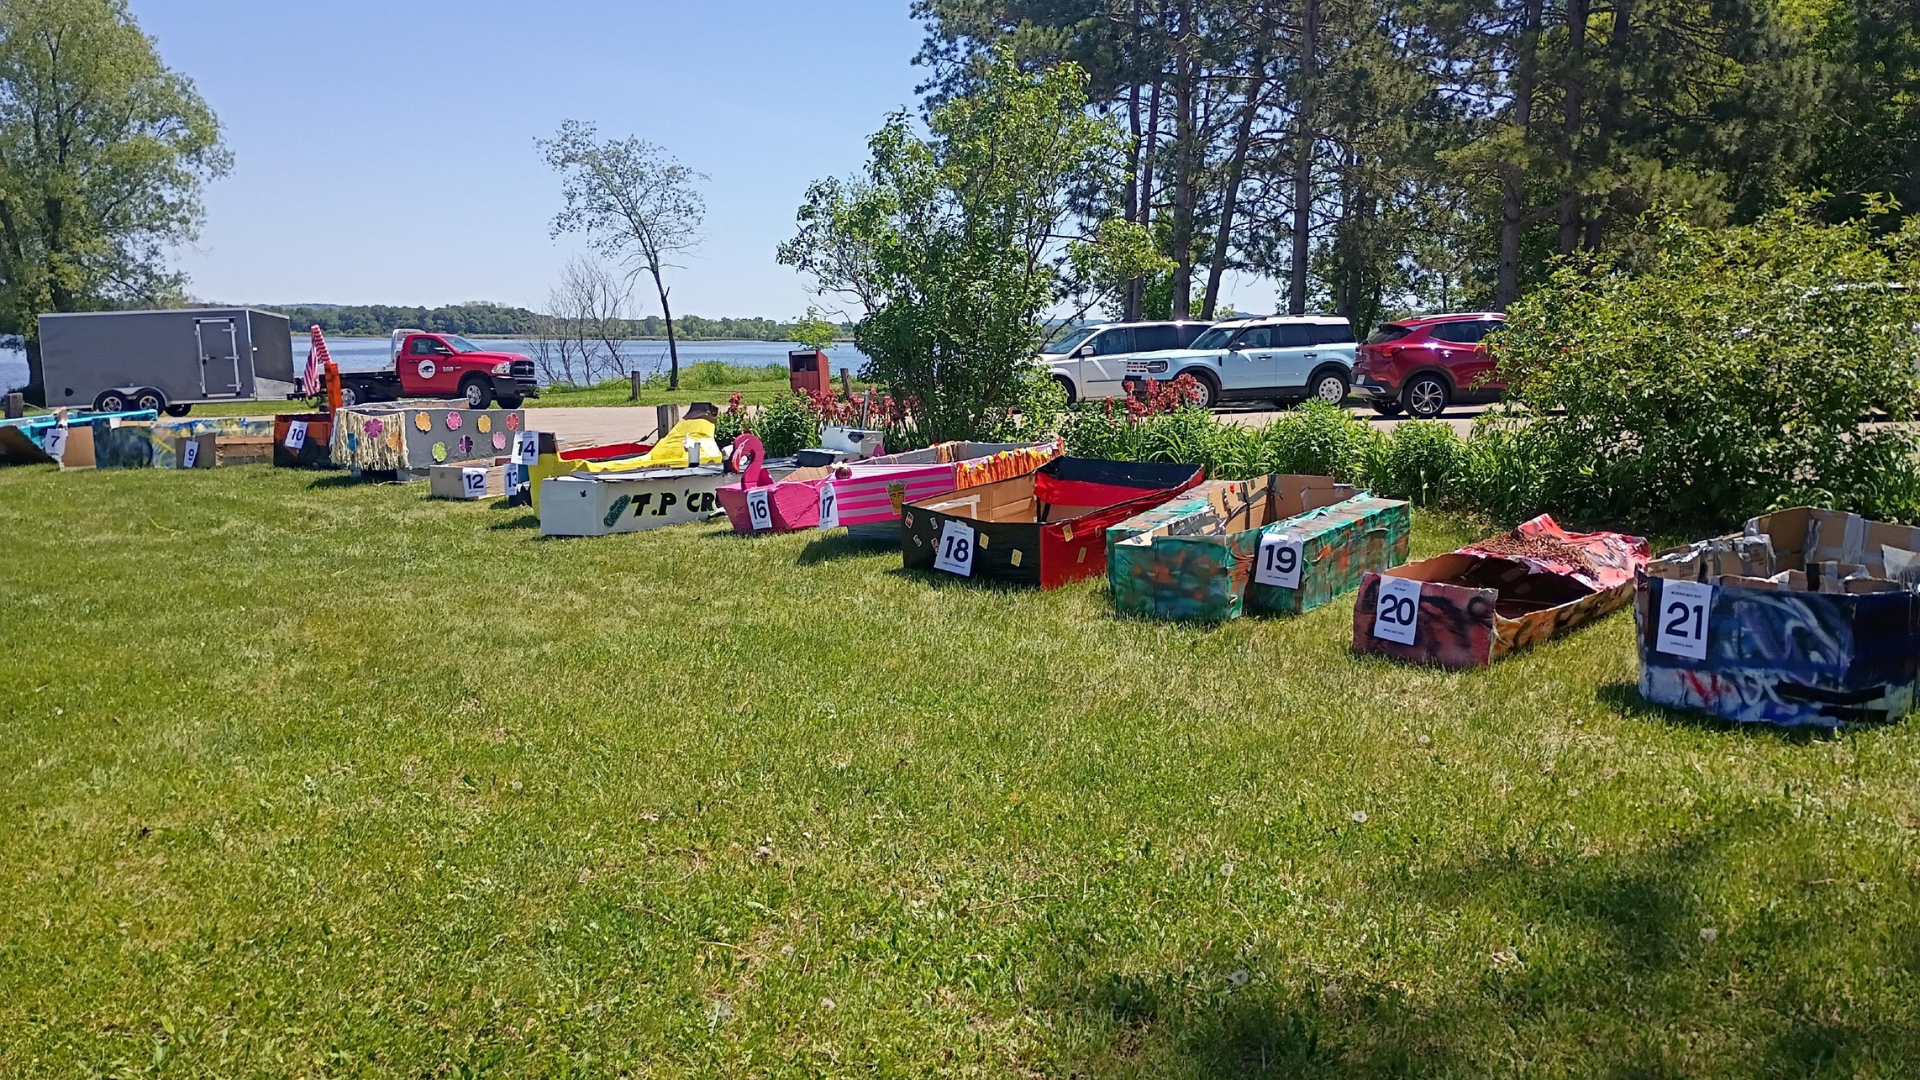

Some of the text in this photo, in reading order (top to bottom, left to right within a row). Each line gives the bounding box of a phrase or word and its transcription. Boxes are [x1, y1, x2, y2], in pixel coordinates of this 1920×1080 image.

[51, 435, 60, 447] 7
[291, 429, 304, 441] 10
[188, 448, 195, 461] 9
[517, 440, 536, 457] 14
[465, 473, 485, 490] 12
[604, 494, 631, 528] Cottonelle
[631, 492, 677, 518] T.P
[750, 499, 768, 520] 16
[822, 495, 834, 519] 17
[944, 535, 969, 562] 18
[1265, 544, 1297, 574] 19
[1379, 593, 1415, 626] 20
[1665, 601, 1704, 641] 21
